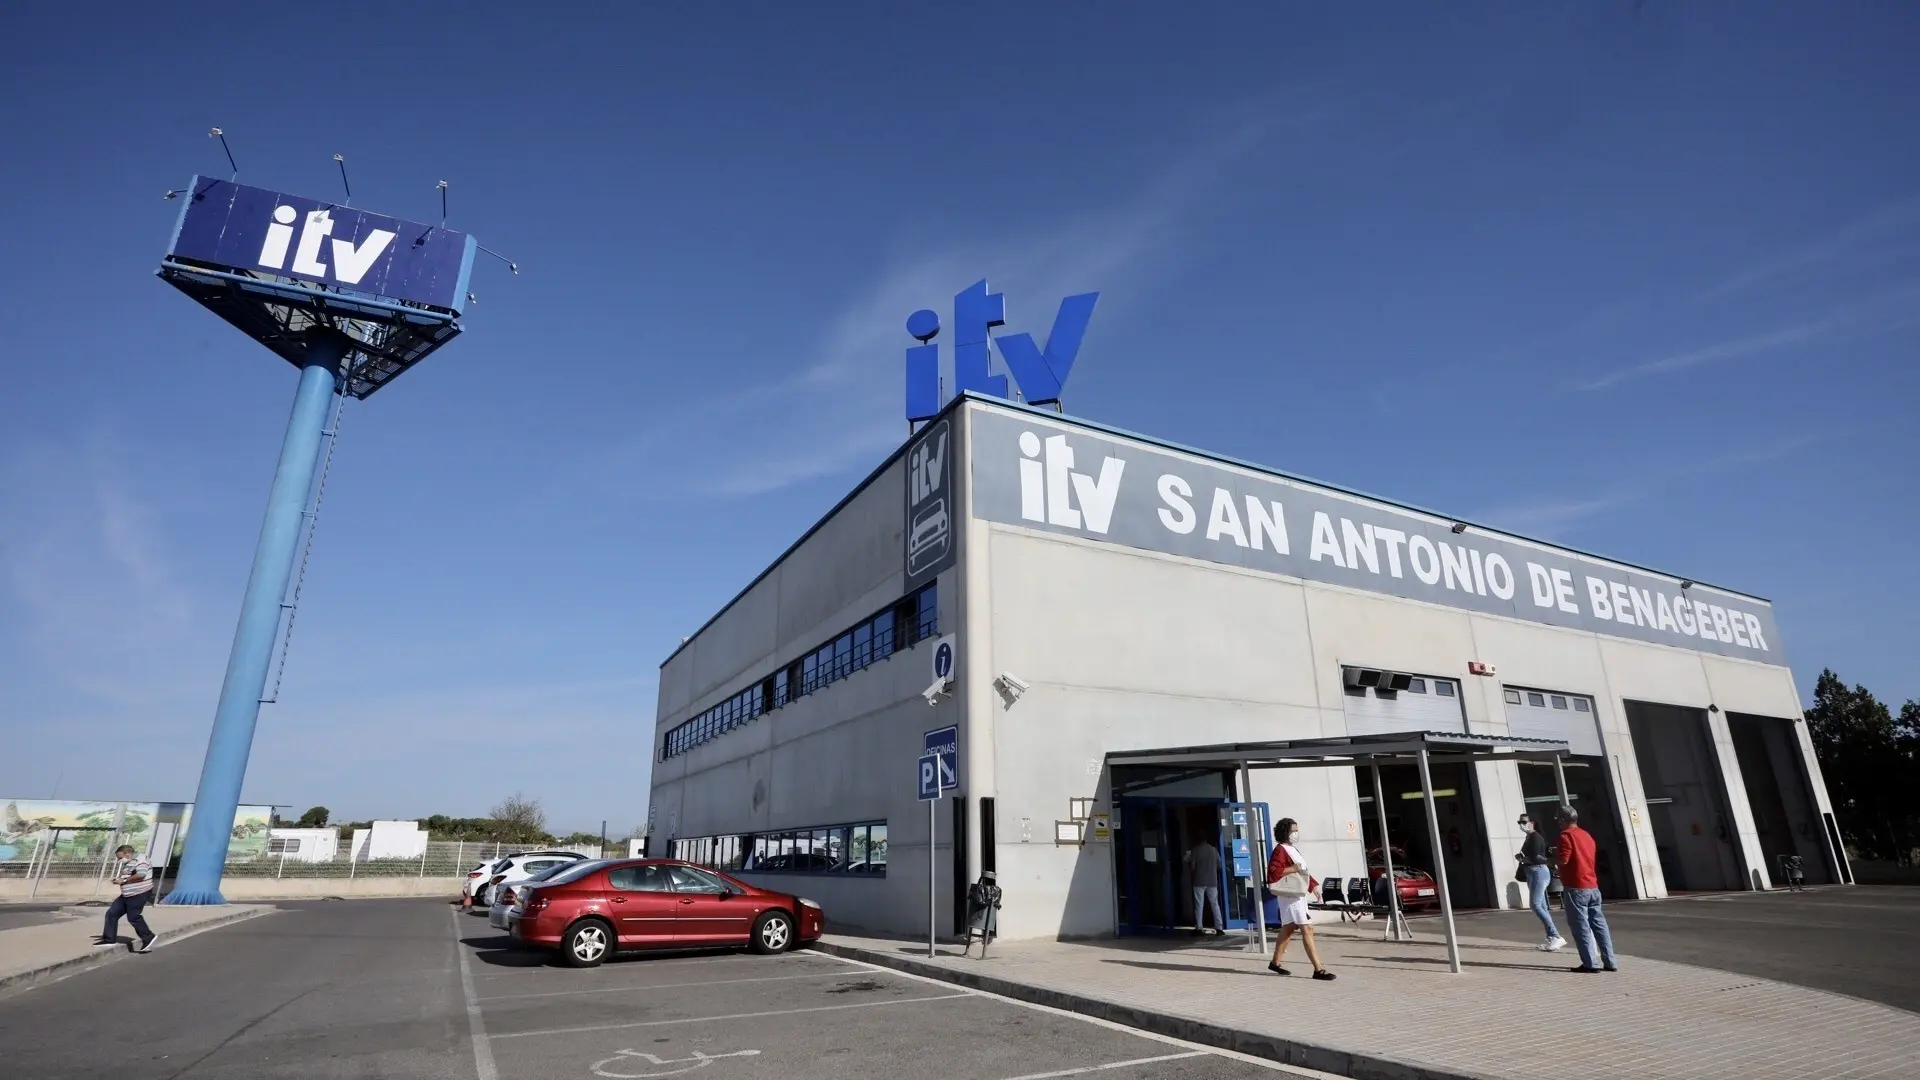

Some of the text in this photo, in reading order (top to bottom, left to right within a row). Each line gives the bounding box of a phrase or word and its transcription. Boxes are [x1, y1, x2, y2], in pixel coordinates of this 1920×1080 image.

[258, 205, 396, 285] itv
[905, 277, 1100, 421] itv
[911, 431, 947, 507] itv
[1019, 431, 1769, 651] itv SAN ANTONIO DE BENAGEBER
[922, 762, 934, 794] P
